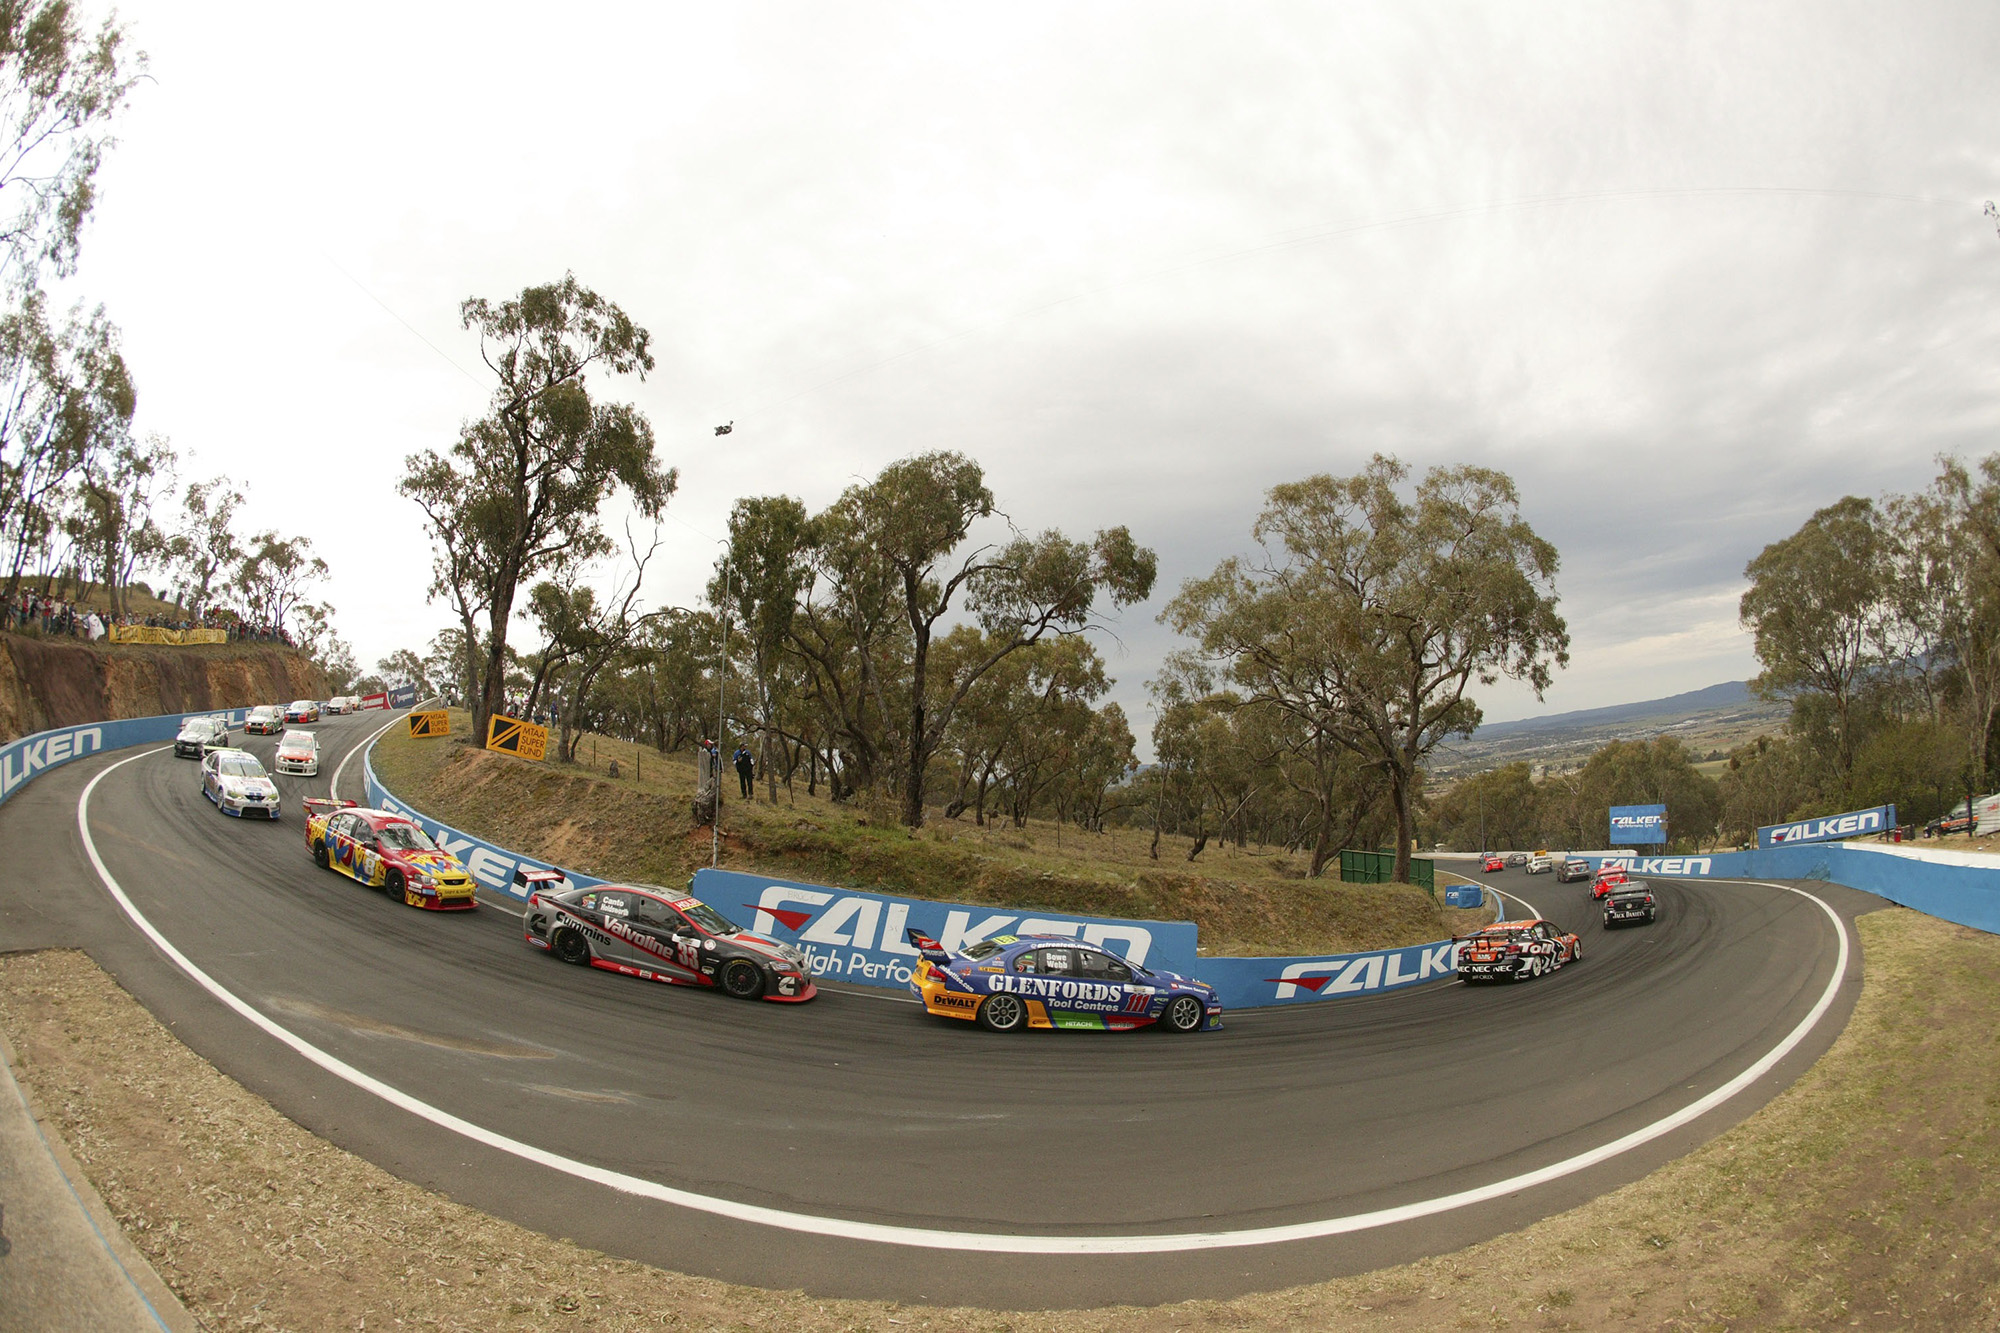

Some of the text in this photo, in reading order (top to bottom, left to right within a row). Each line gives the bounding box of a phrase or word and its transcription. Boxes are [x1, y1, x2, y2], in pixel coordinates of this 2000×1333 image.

[523, 727, 546, 739] MTAA
[521, 736, 545, 749] SUPER
[519, 745, 542, 758] FUND
[0, 727, 102, 798] LKEN
[1770, 812, 1880, 844] FALKEN
[364, 858, 376, 877] 8
[1600, 858, 1711, 875] FALKEN
[603, 896, 625, 907] Canto
[555, 911, 612, 946] Cummins
[603, 914, 674, 960] Valvoline
[677, 942, 699, 970] 33
[1518, 942, 1553, 954] Toll
[795, 943, 912, 984] High Perfo
[1046, 953, 1067, 961] Bowe
[1046, 960, 1068, 969] Webb
[1472, 965, 1490, 973] NEC
[988, 974, 1122, 1003] GLENFORDS
[1048, 998, 1119, 1012] Tool Centres
[1122, 993, 1151, 1013] 111
